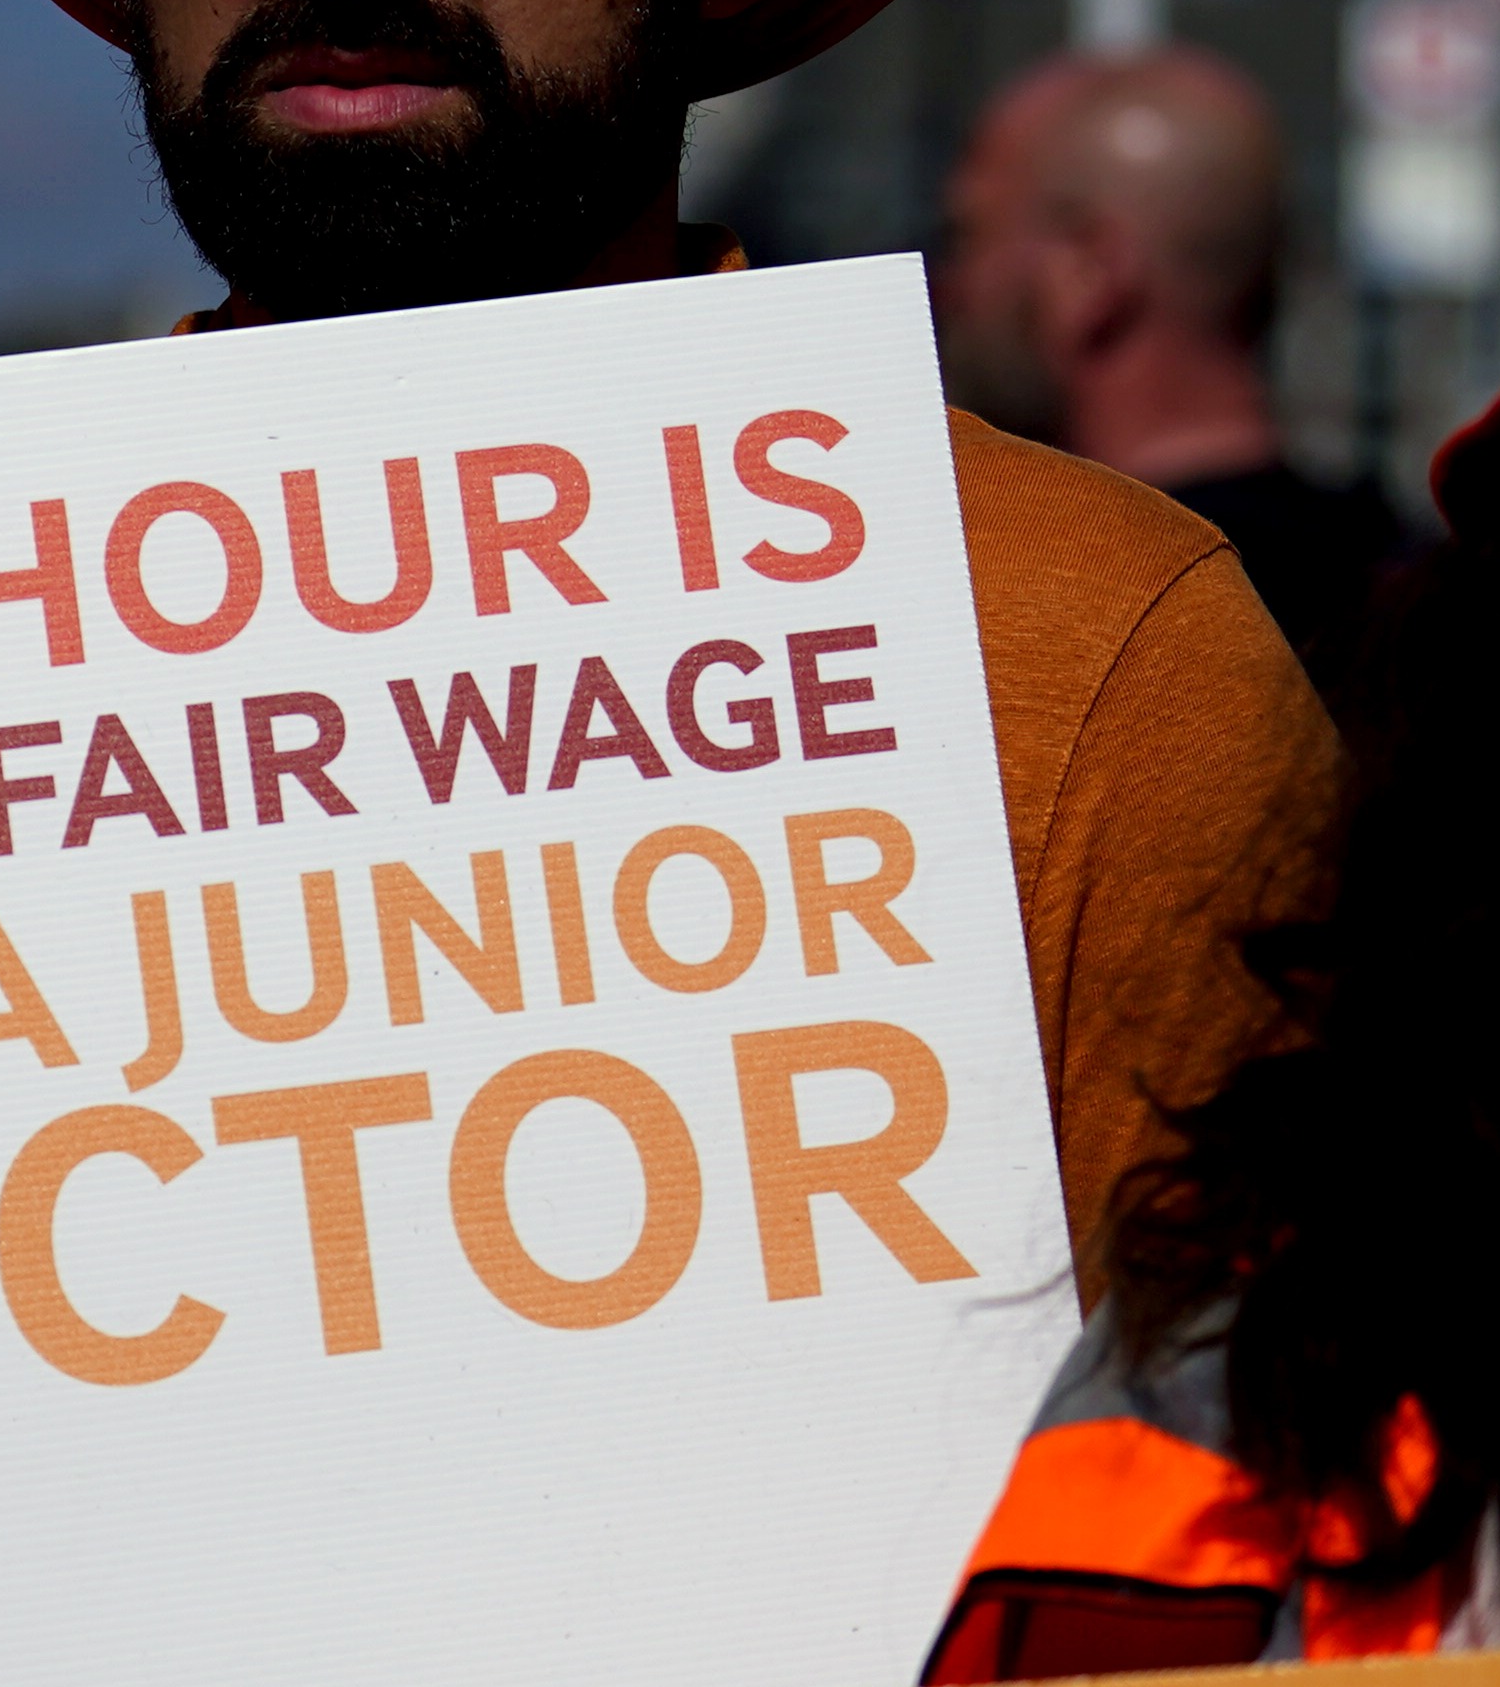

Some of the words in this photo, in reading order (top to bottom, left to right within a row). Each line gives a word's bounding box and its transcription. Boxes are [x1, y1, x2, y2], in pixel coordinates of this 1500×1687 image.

[663, 410, 865, 592] IS
[388, 625, 896, 804] WAGE
[123, 808, 932, 1092] JUNIOR
